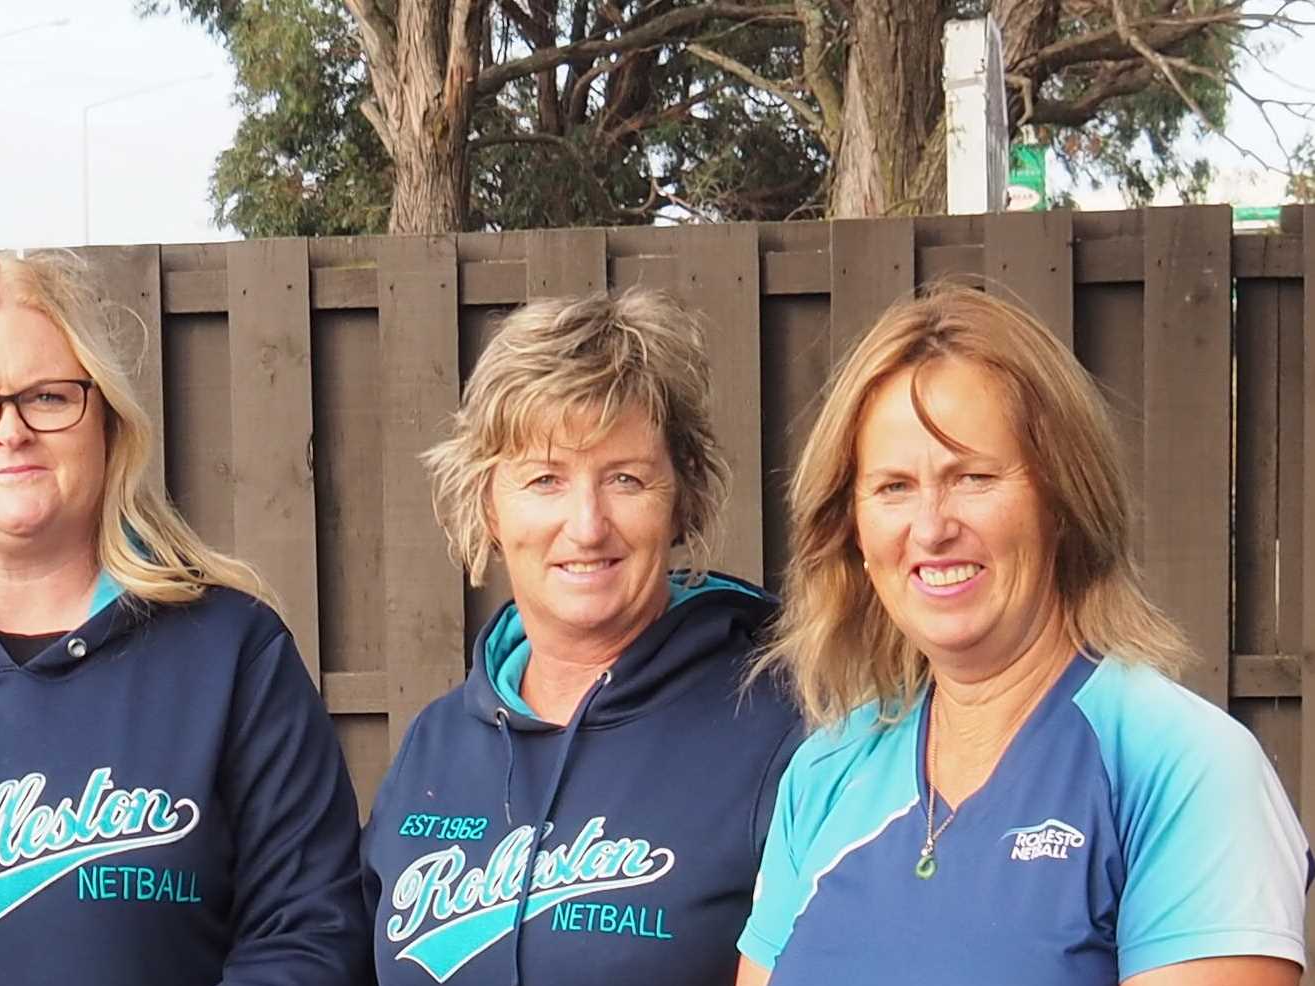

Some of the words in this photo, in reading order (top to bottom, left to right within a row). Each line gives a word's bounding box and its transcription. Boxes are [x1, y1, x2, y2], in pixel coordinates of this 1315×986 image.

[399, 814, 441, 839] EST
[437, 816, 488, 840] 1962
[77, 865, 202, 903] NETBALL
[551, 902, 674, 940] NETBALL
